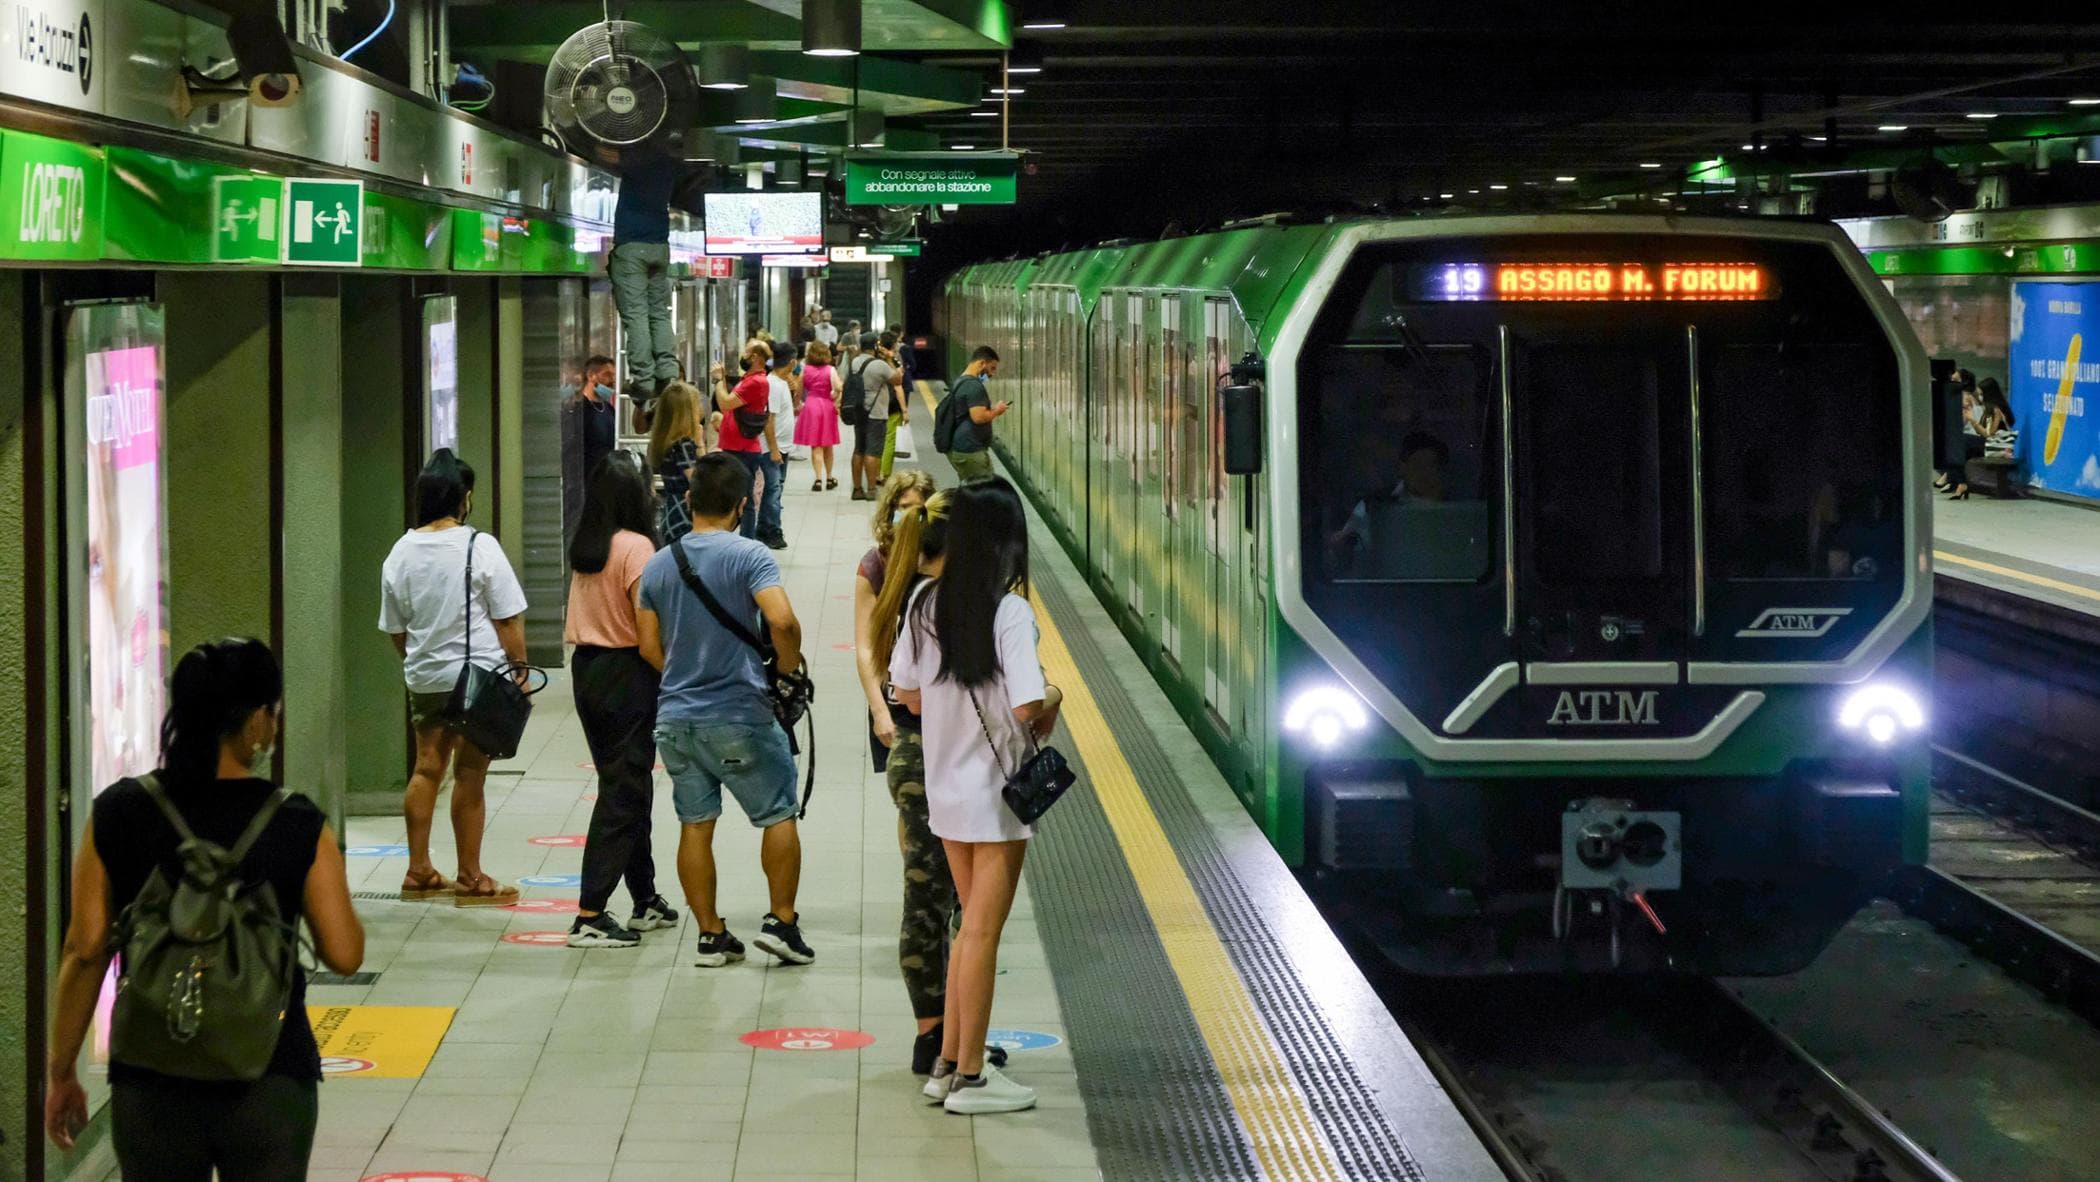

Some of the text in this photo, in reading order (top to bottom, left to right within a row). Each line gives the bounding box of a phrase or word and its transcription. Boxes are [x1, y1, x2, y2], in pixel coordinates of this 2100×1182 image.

[37, 11, 76, 73] Abruzzi
[865, 182, 991, 192] abbandonare la stazione
[881, 169, 976, 181] Con segnale attivo
[19, 162, 85, 243] LORETO
[1443, 268, 1758, 292] 19 ASSAGO M. FORUM
[1769, 615, 1816, 631] ATM
[1546, 690, 1660, 725] ATM
